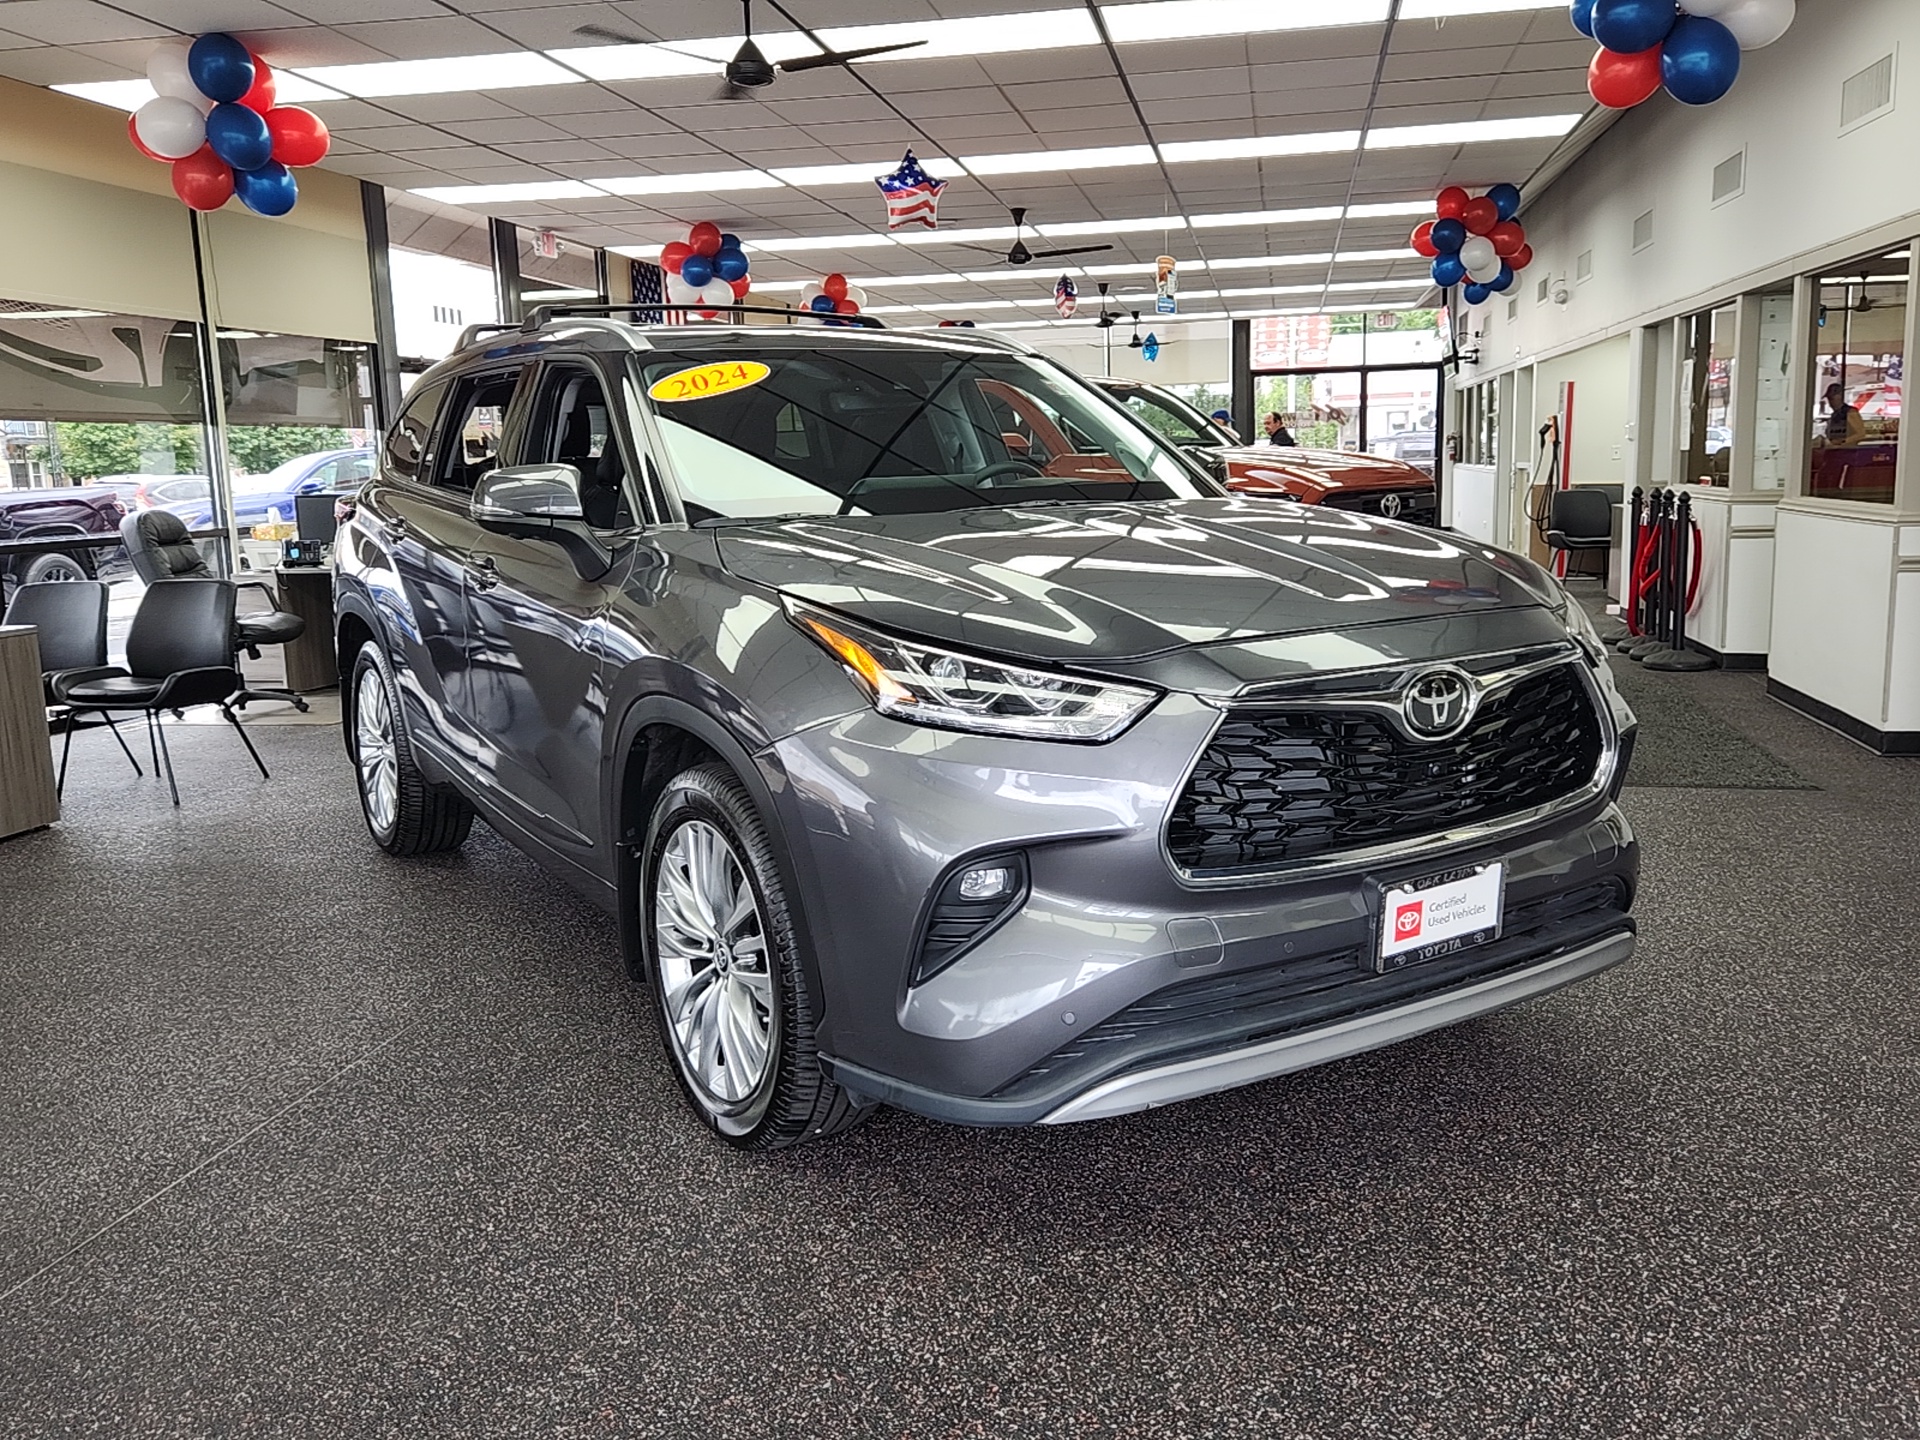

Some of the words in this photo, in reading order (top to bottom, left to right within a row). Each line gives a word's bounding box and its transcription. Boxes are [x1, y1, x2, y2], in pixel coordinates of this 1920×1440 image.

[1377, 314, 1393, 326] EXIT
[670, 364, 748, 397] 2024
[1429, 893, 1467, 913] Certified
[1428, 912, 1451, 927] Used
[1452, 904, 1487, 922] Vehicles
[1418, 938, 1462, 960] TOYOTA
